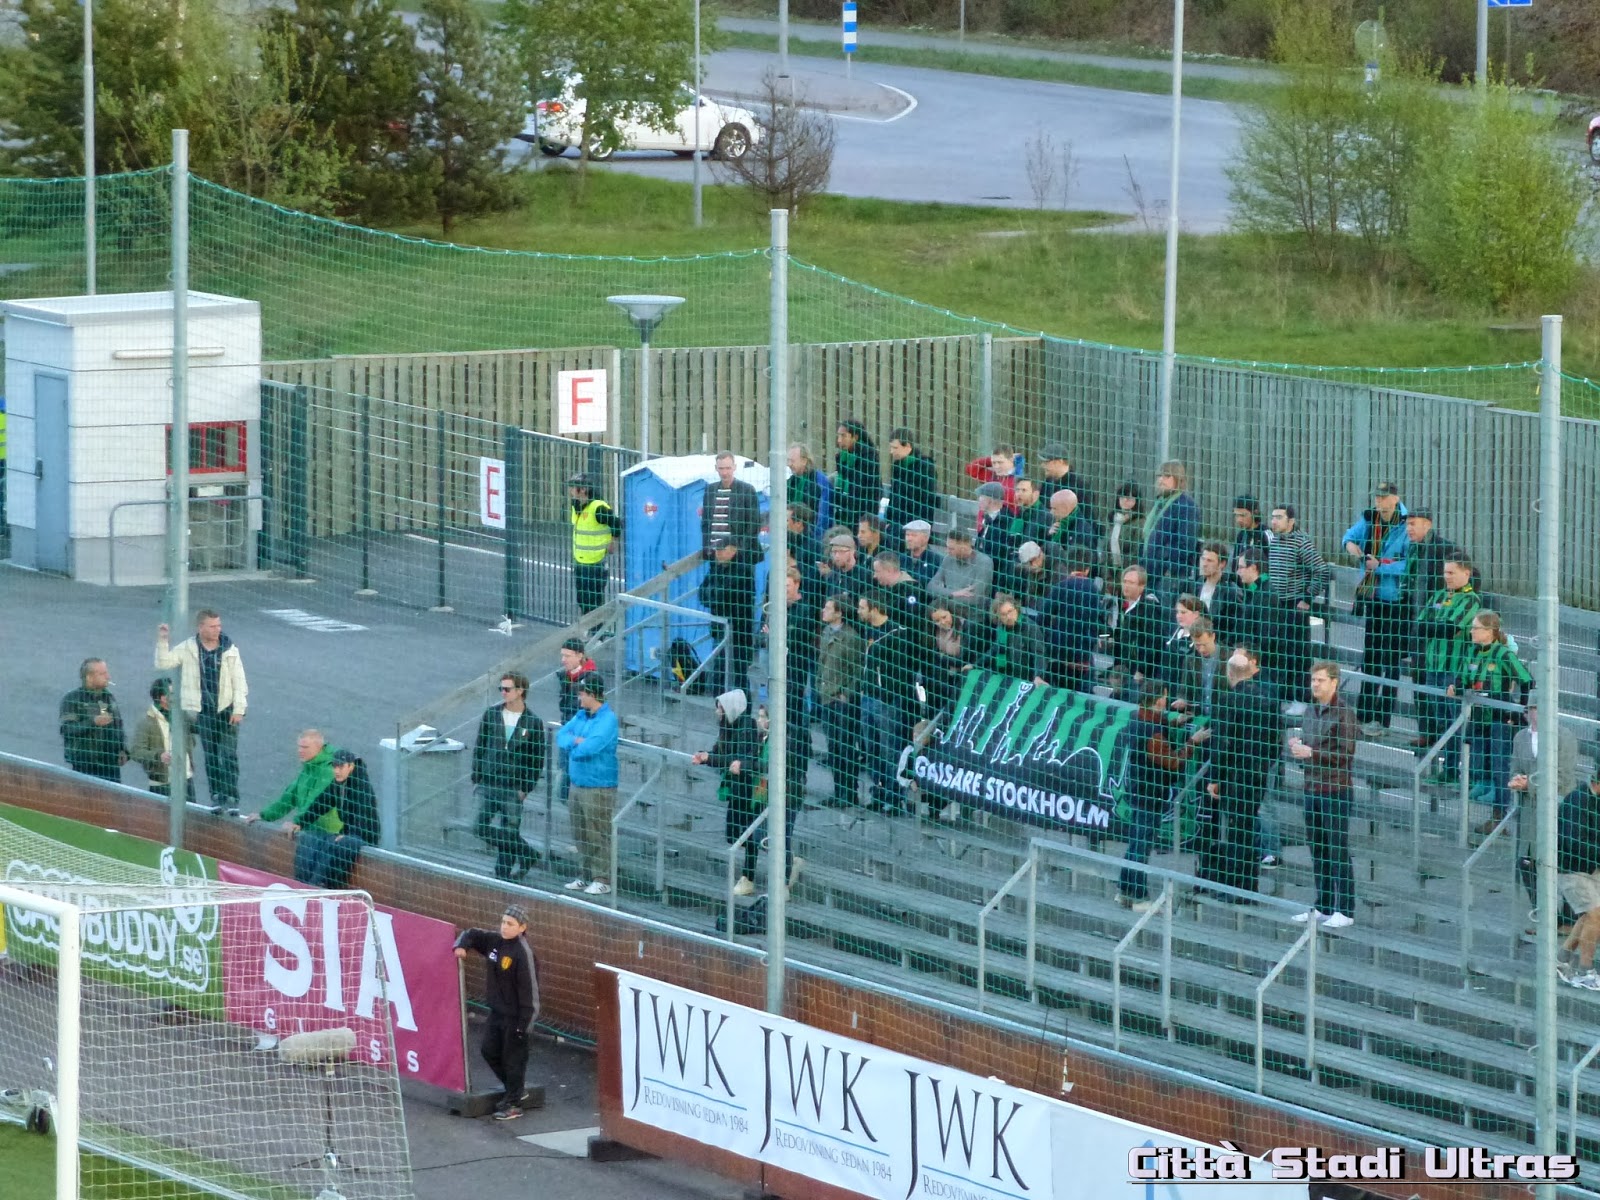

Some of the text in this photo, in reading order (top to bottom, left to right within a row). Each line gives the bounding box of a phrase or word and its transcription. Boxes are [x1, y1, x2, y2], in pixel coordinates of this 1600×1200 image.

[571, 376, 595, 426] F
[486, 465, 501, 520] E
[914, 755, 1110, 828] GAISARE STOCKHOLM
[13, 877, 178, 966] CABUDDY
[259, 882, 419, 1032] SIA
[263, 1007, 420, 1073] GSS
[628, 986, 737, 1112] JWK
[730, 1115, 749, 1134] 1984
[759, 1024, 879, 1154] JWK
[775, 1127, 893, 1182] REDOVISNING SEDAN 1984
[904, 1068, 1031, 1200] JWK
